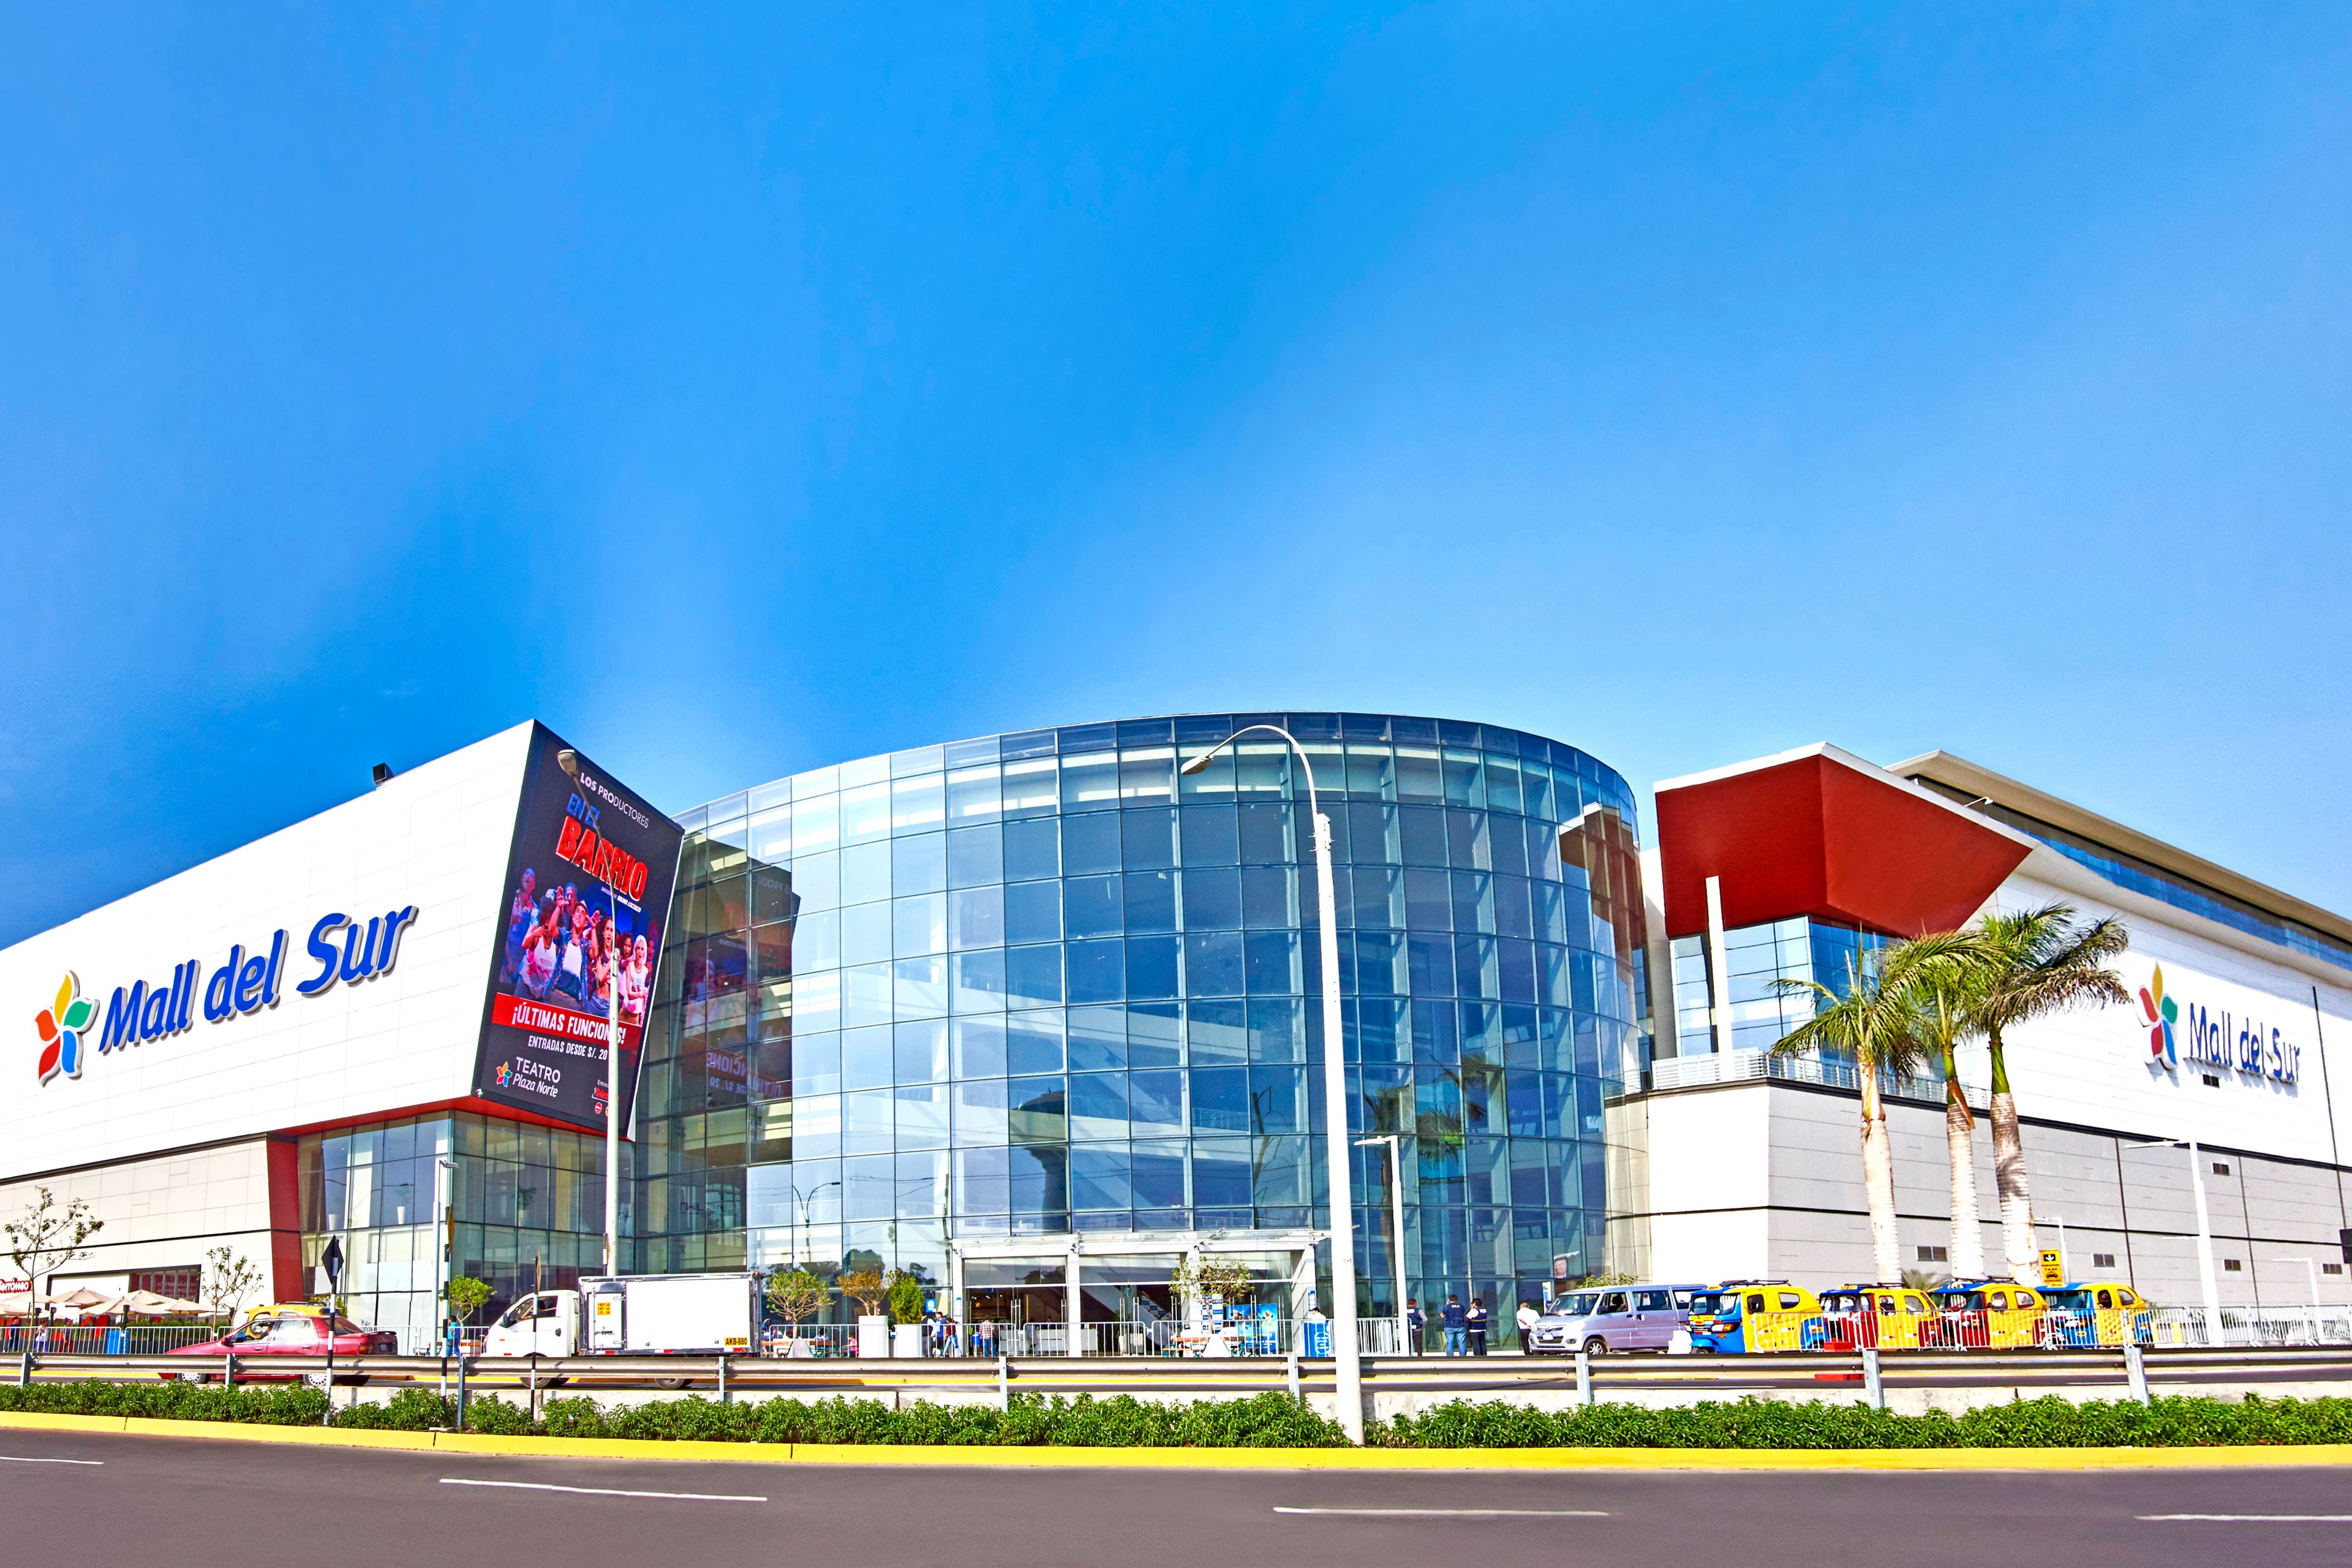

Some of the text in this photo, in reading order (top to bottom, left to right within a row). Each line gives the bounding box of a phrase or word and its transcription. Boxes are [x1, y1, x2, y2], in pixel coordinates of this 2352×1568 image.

[567, 793, 601, 829] EN EL
[580, 772, 649, 829] LOS PRODUCTORES
[555, 815, 649, 902] BARRIO
[99, 905, 420, 1055] Mall del Sur
[511, 1001, 627, 1044] ¡ÚLTIMAS FUNCIONS!
[2189, 1002, 2301, 1084] Mall del Sur
[528, 1035, 608, 1060] ENTRADAS DESDE S/. 20
[512, 1073, 559, 1098] Plaza Norte
[516, 1056, 561, 1084] TEATRO
